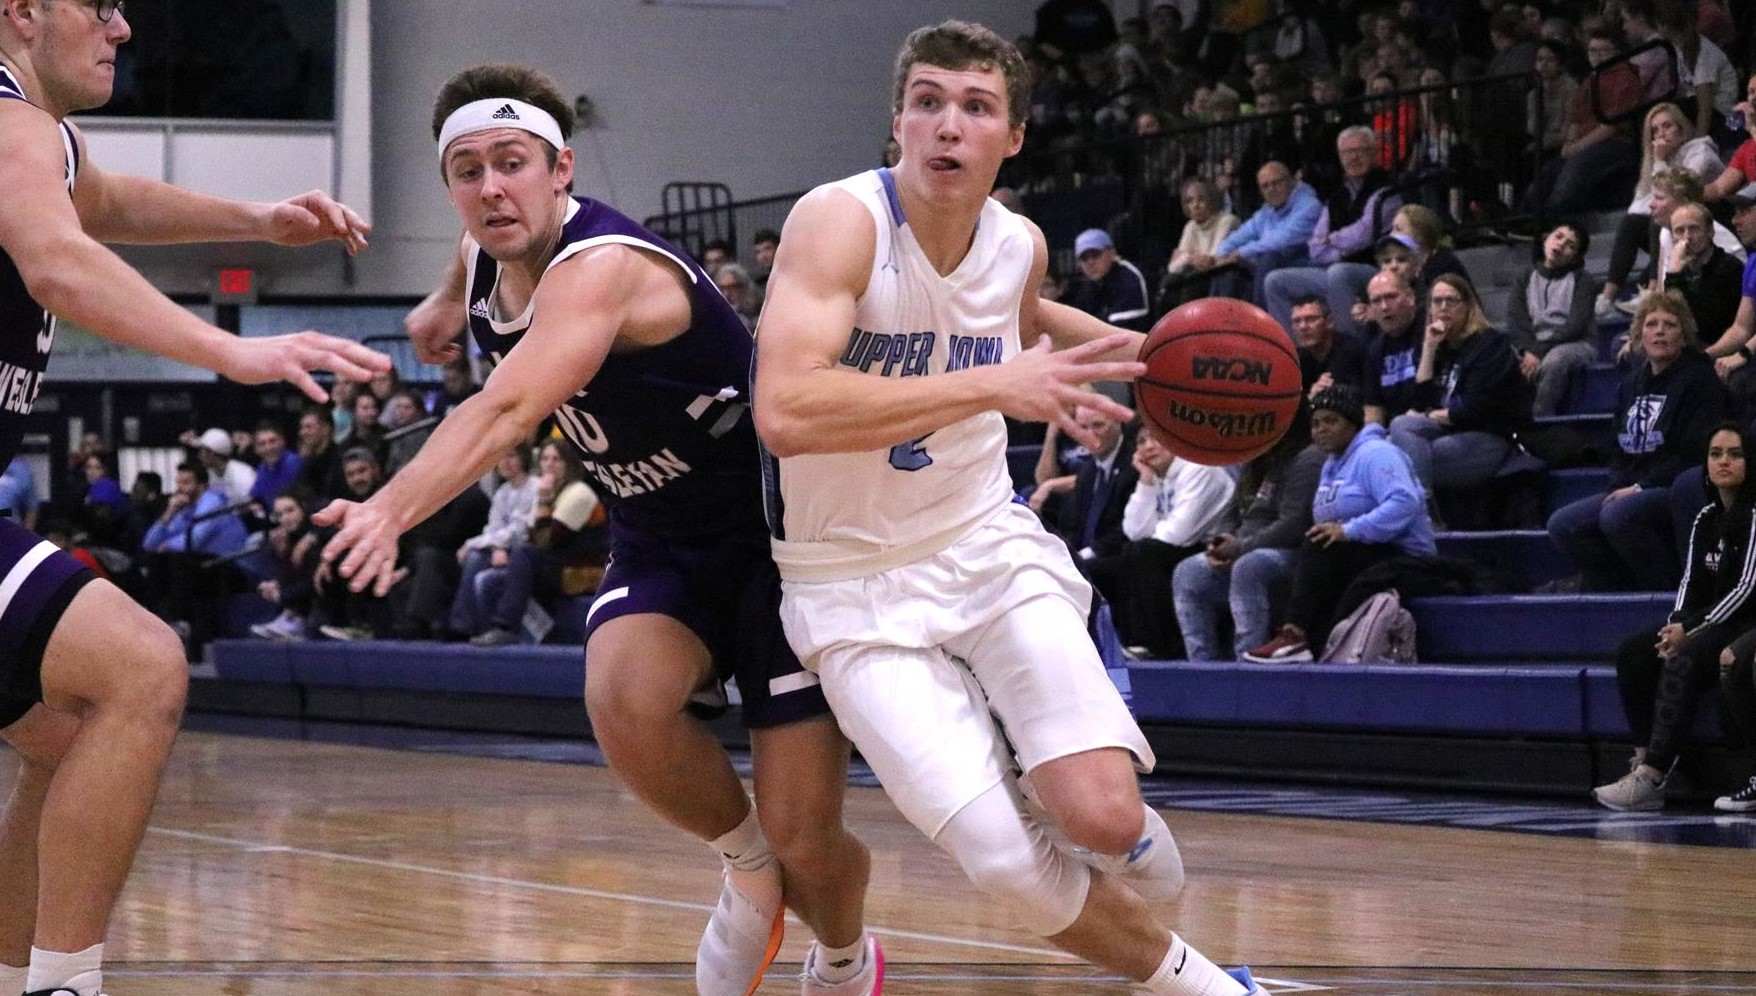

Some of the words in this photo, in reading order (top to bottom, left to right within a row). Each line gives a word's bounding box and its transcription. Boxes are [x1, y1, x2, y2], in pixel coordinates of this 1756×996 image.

[839, 327, 936, 377] UPPER
[1192, 354, 1274, 386] NCAA
[1168, 400, 1276, 437] Wilson
